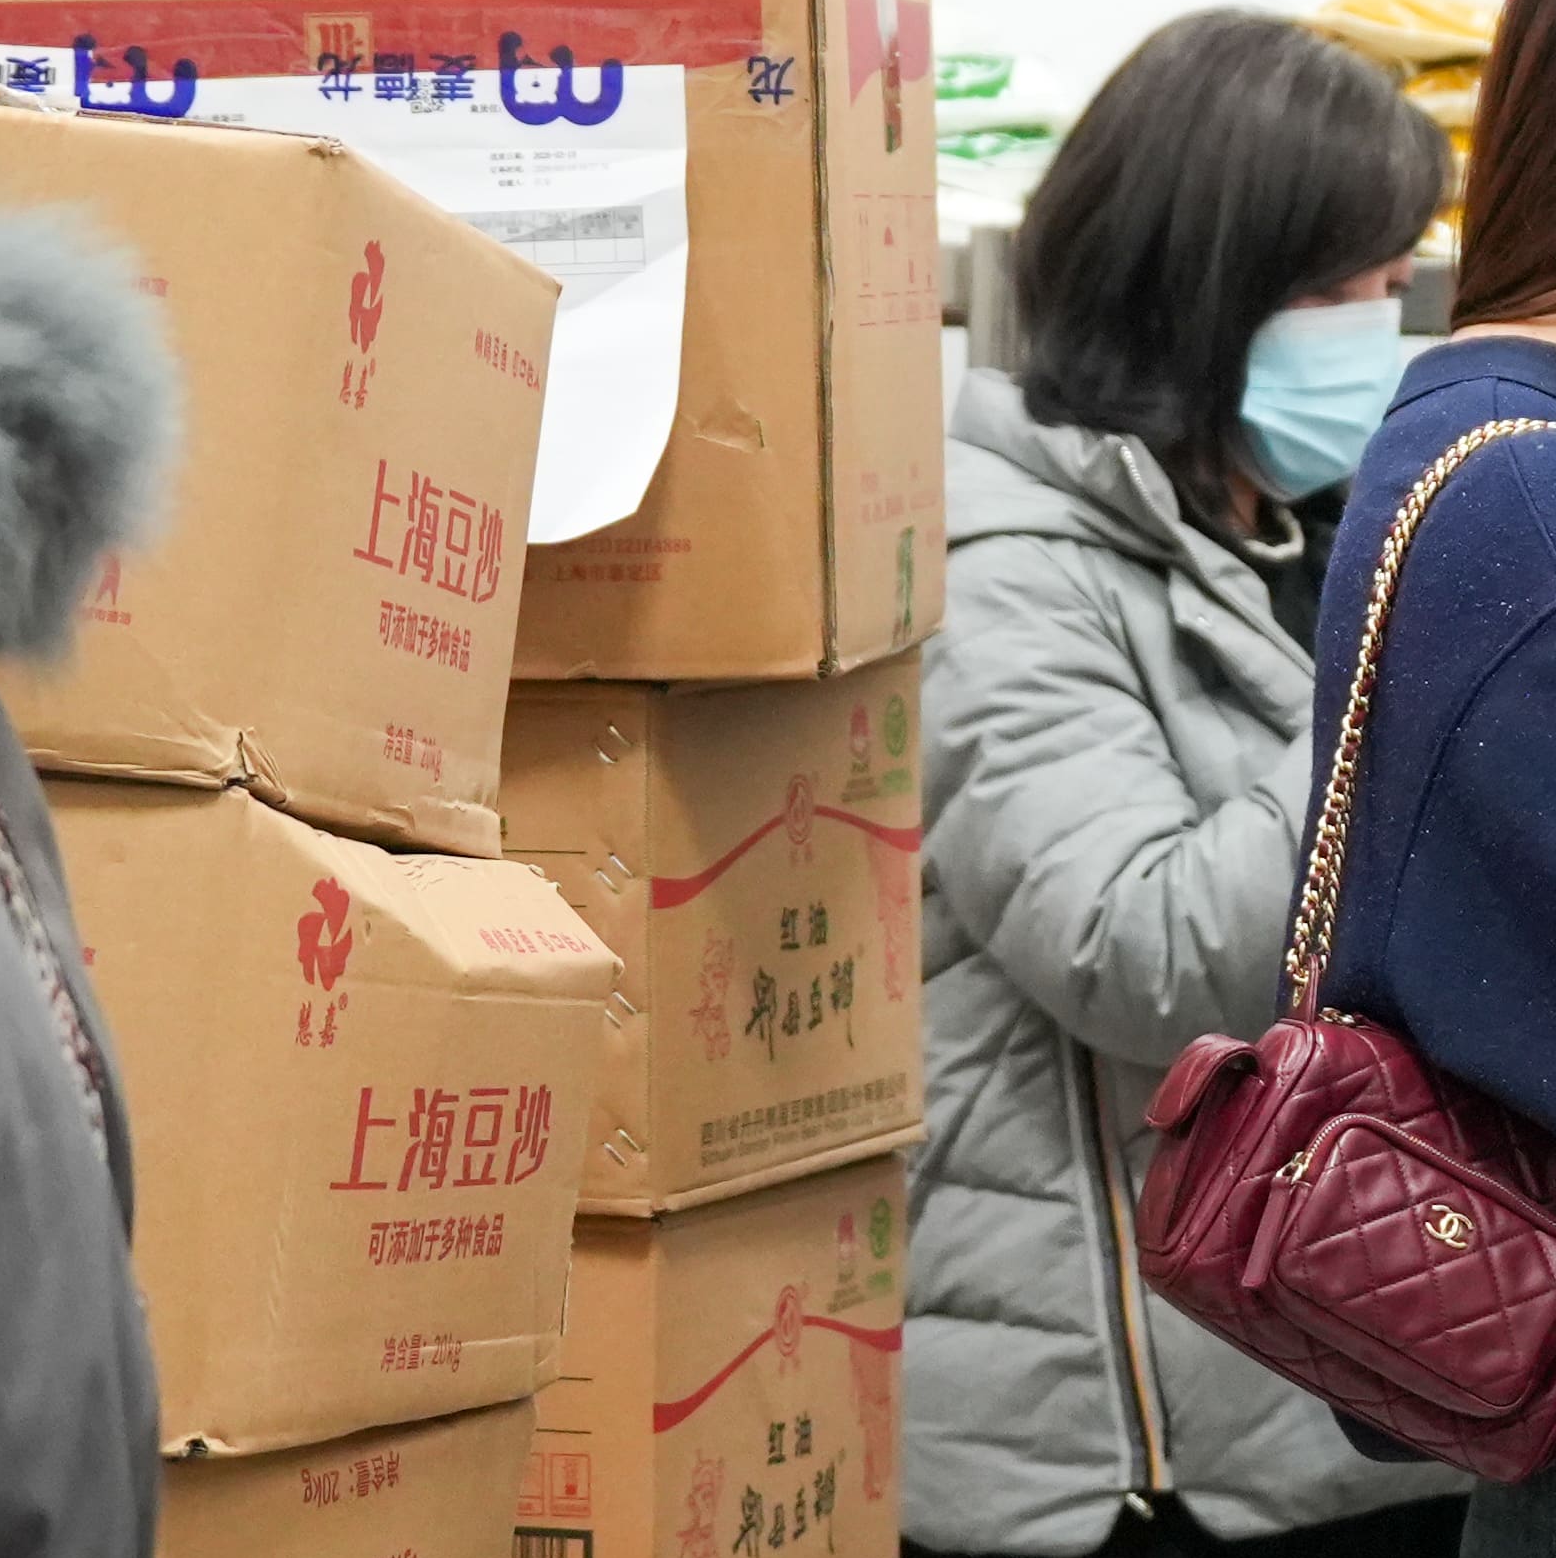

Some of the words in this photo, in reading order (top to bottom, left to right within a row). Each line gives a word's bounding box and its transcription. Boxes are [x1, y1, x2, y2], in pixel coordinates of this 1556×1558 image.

[747, 55, 797, 106] 龙
[353, 458, 503, 604] 上海豆沙
[379, 599, 472, 673] 可添加于多种食品
[329, 1084, 553, 1192] 上海豆沙
[369, 1213, 504, 1267] 可添加于多种食品
